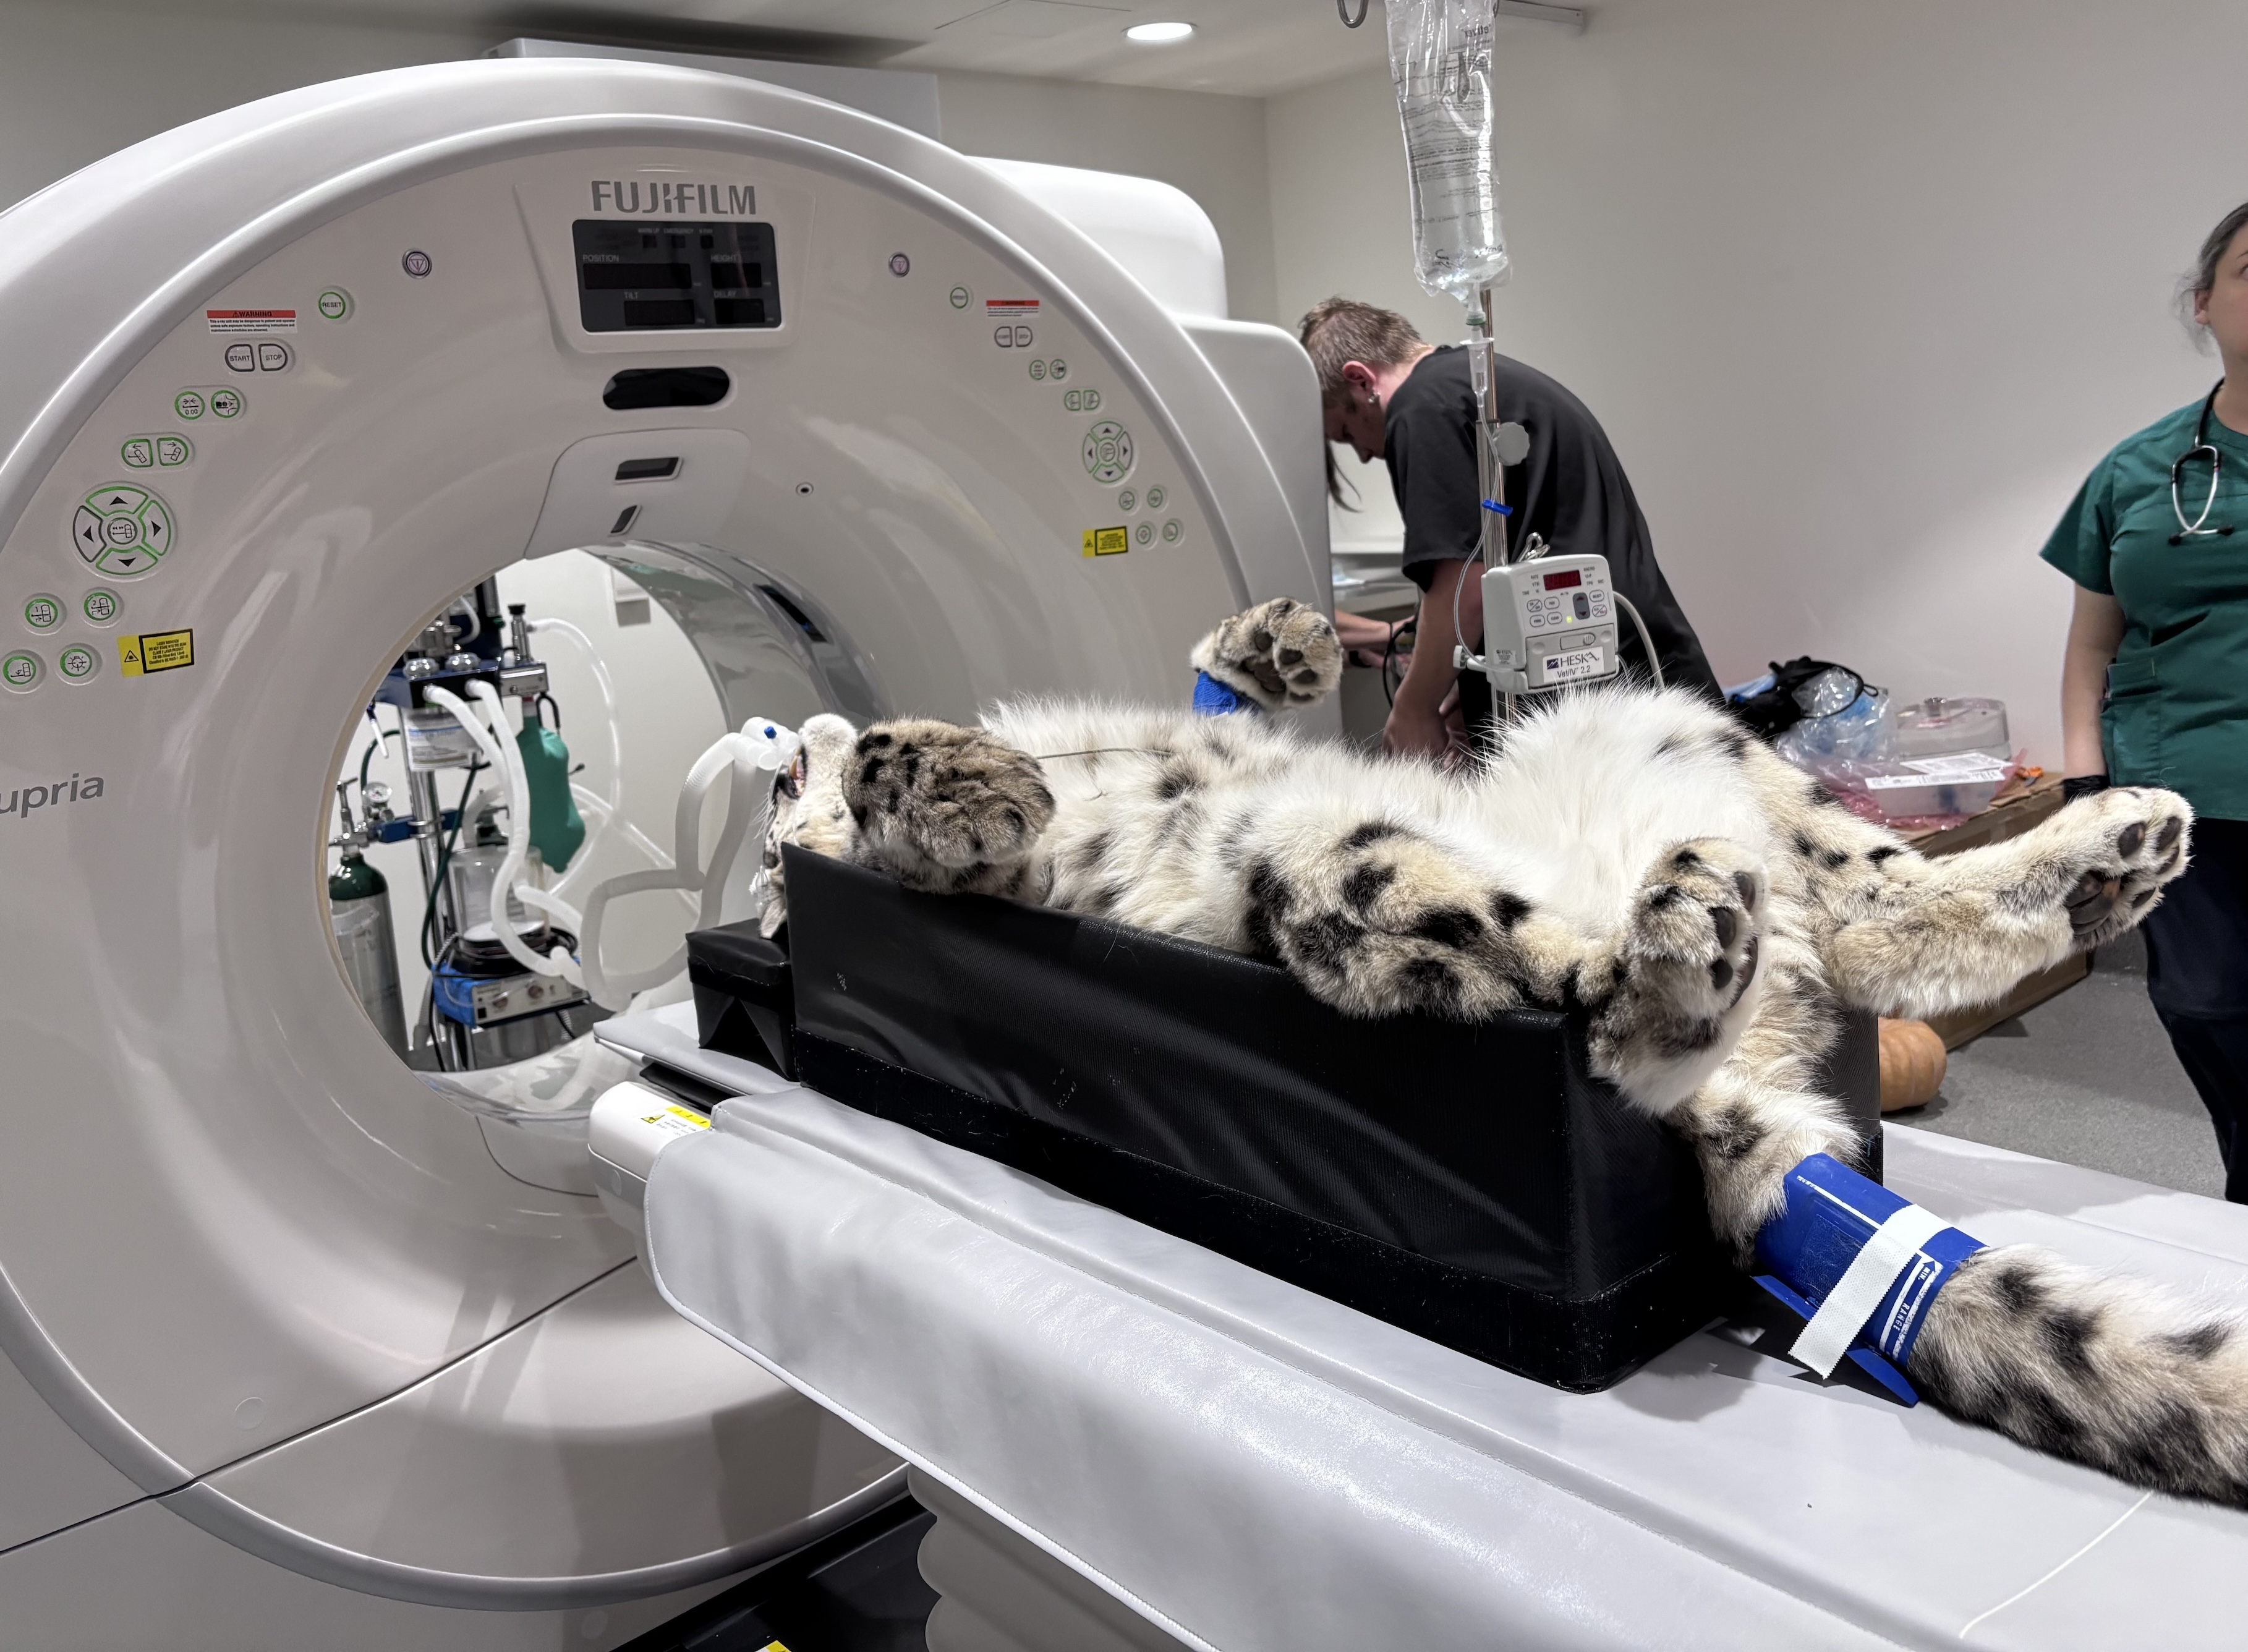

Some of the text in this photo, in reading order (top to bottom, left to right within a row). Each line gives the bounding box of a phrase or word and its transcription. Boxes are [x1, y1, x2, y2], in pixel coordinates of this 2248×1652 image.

[591, 181, 756, 215] FUJIFILM
[582, 254, 619, 262] POSITION
[711, 254, 738, 262] HEIGHT
[1560, 652, 1598, 667] HESKA
[1581, 665, 1590, 674] 2.2
[0, 773, 104, 819] upria
[1917, 1266, 1931, 1281] MIN.
[1893, 1303, 1910, 1331] RANGE
